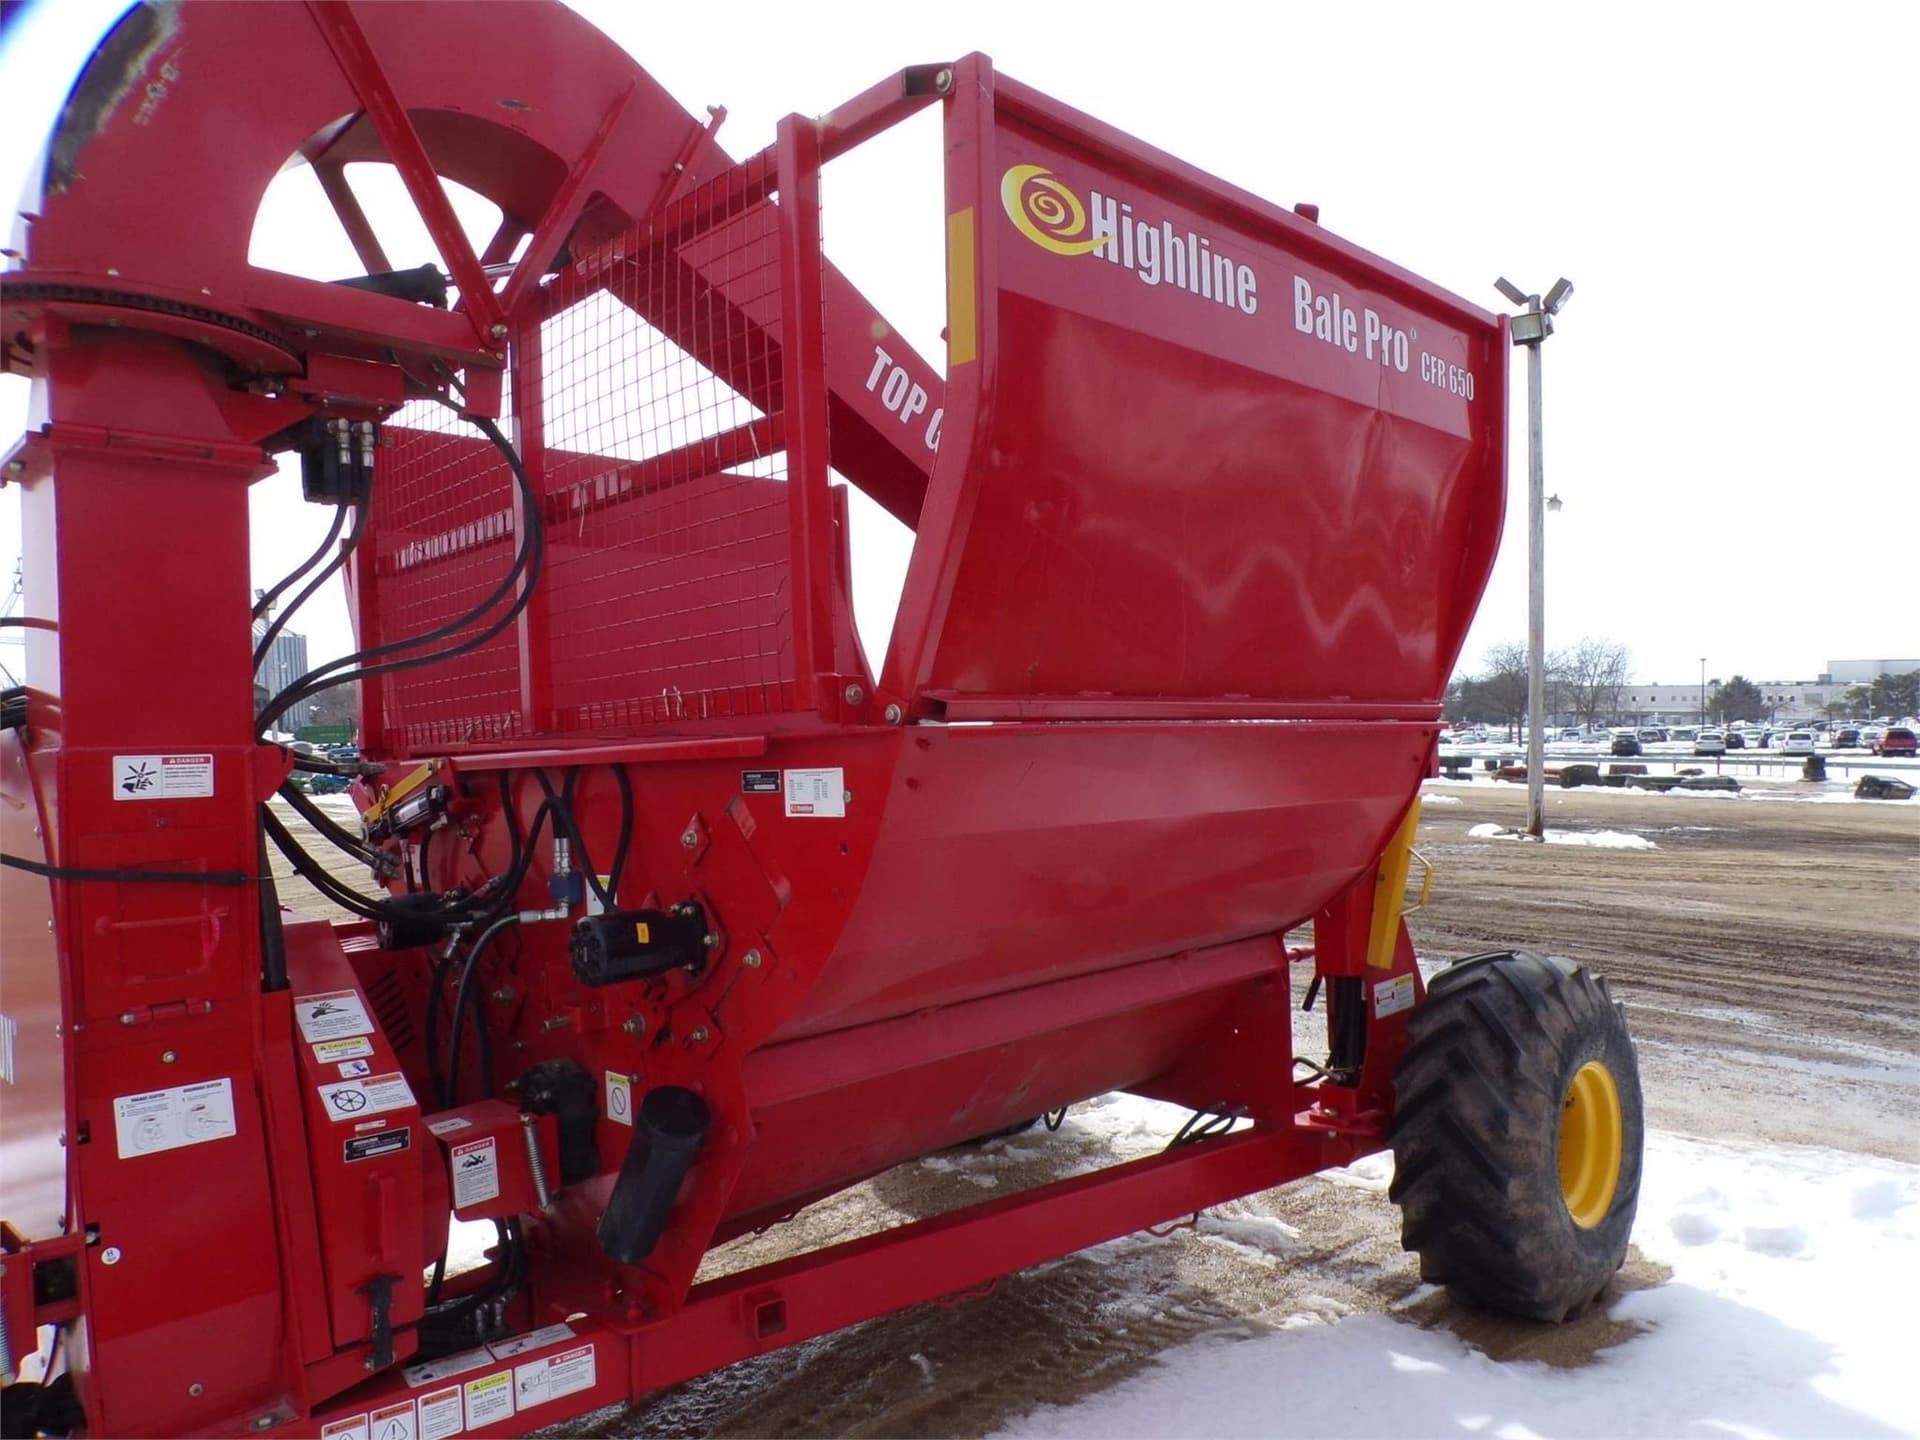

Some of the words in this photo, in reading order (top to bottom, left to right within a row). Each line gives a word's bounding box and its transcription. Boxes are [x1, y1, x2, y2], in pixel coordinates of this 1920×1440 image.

[1091, 191, 1257, 315] Highline
[865, 345, 928, 425] TOP
[1294, 275, 1358, 353] Bale
[1421, 351, 1446, 389] CFR
[1449, 364, 1474, 401] 650
